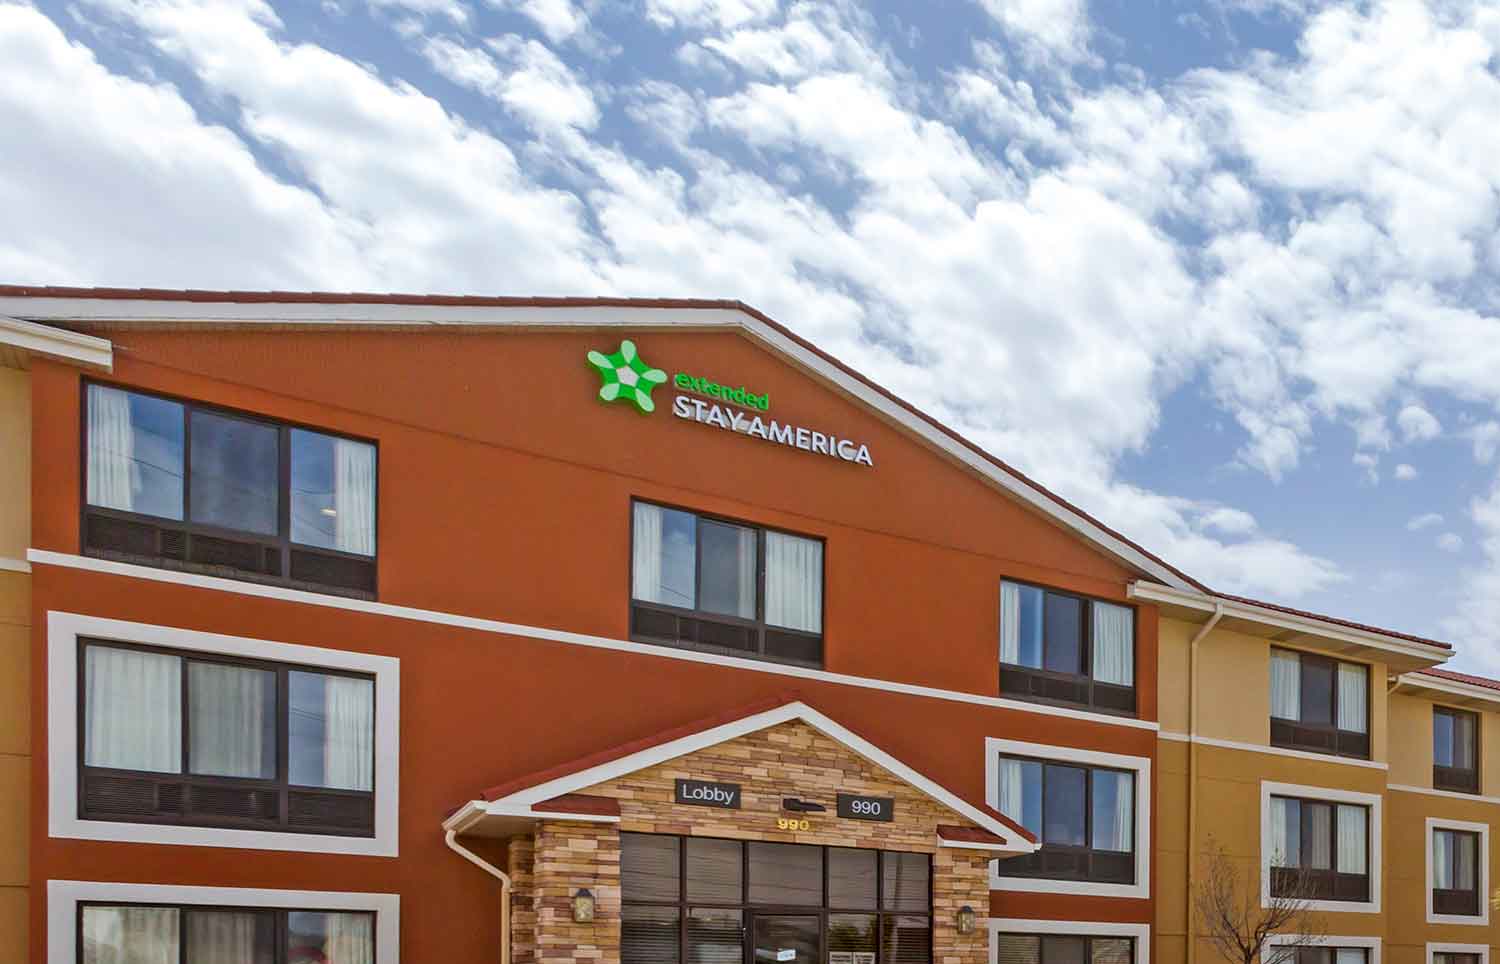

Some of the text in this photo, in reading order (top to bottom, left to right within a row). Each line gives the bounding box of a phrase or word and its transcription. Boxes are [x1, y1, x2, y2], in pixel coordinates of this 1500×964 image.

[673, 371, 768, 410] extended
[672, 395, 873, 466] STAY AMERICA
[682, 784, 734, 805] Lobby
[851, 800, 881, 817] 990
[777, 819, 809, 831] 990
